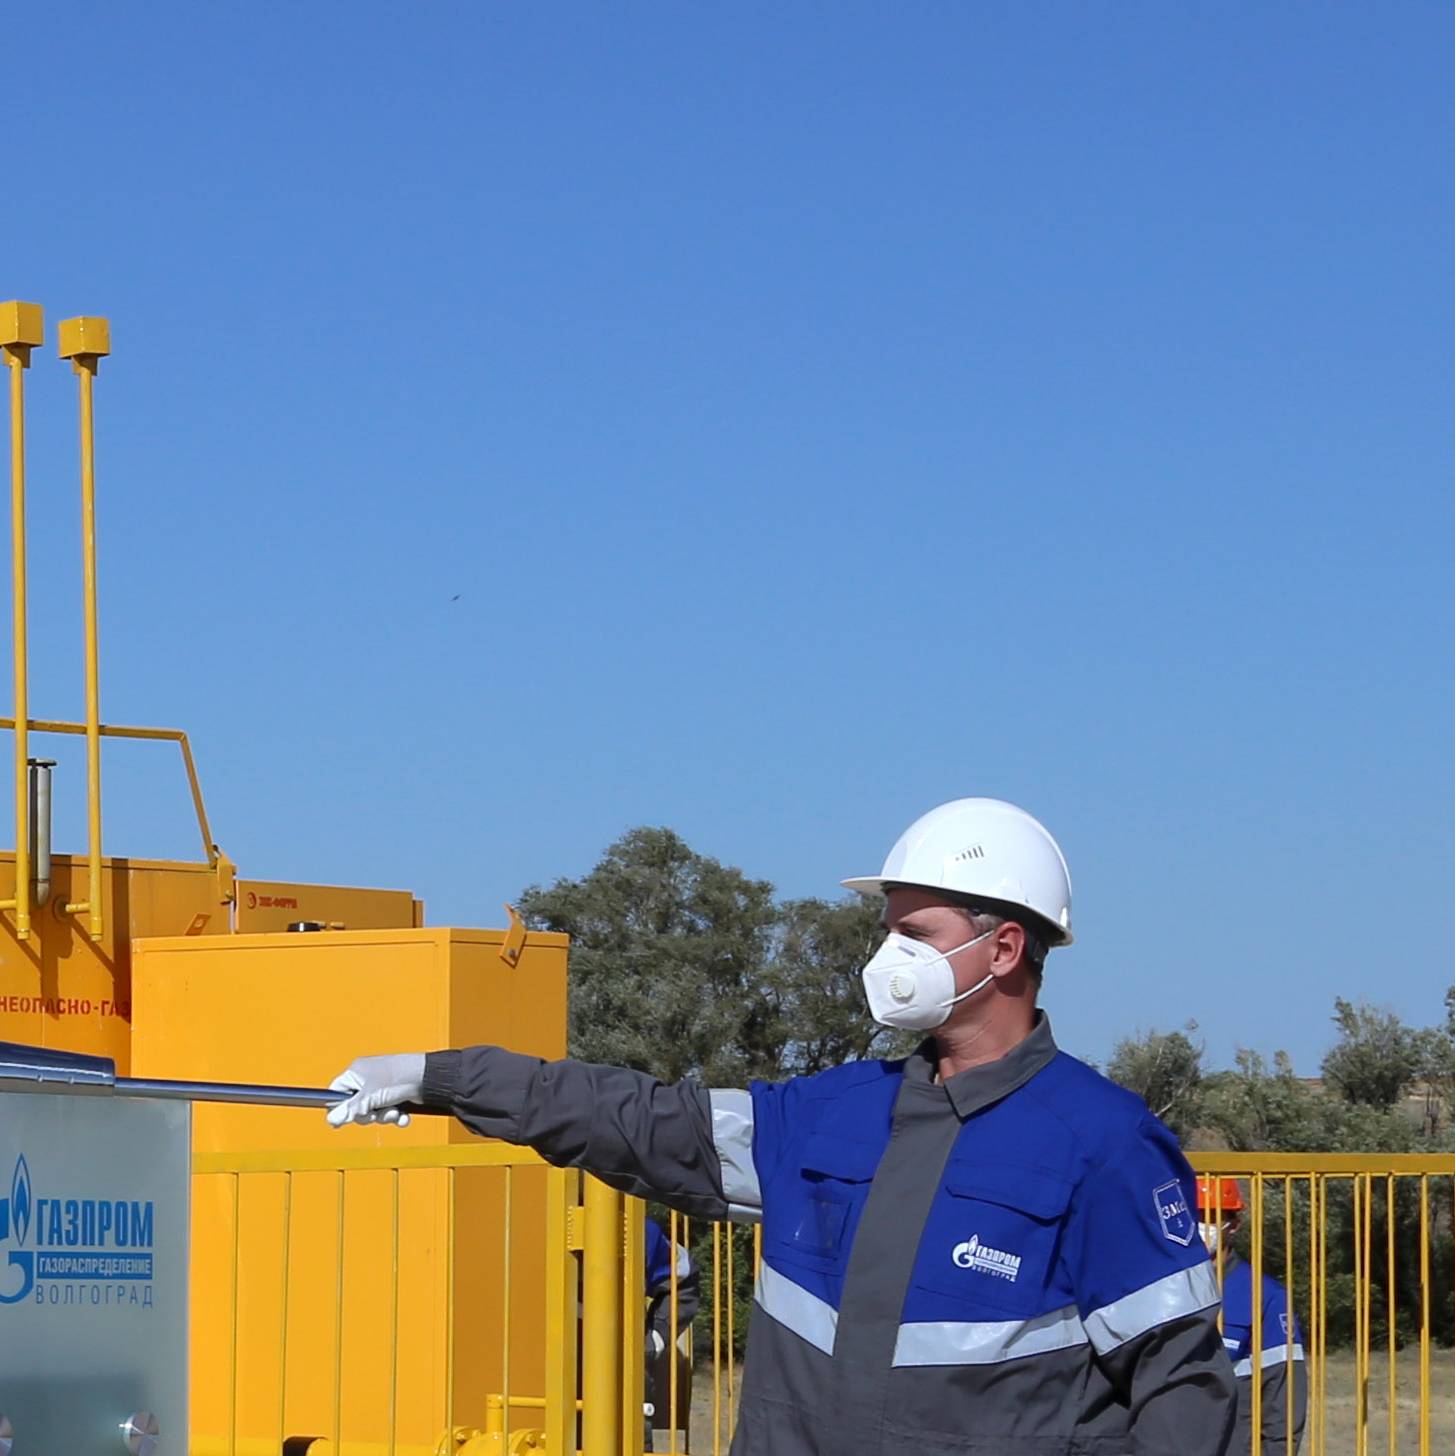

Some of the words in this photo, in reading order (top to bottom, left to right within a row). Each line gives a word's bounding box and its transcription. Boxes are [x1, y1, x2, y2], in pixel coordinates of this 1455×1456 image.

[36, 1199, 153, 1247] ГАЗПРОМ
[39, 1257, 152, 1277] ГАЗОРАСПРЕДЕЛЕНИЕ
[976, 1245, 1022, 1268] ГАЗПРОМ
[36, 1285, 153, 1308] ВОЛГОГРАД
